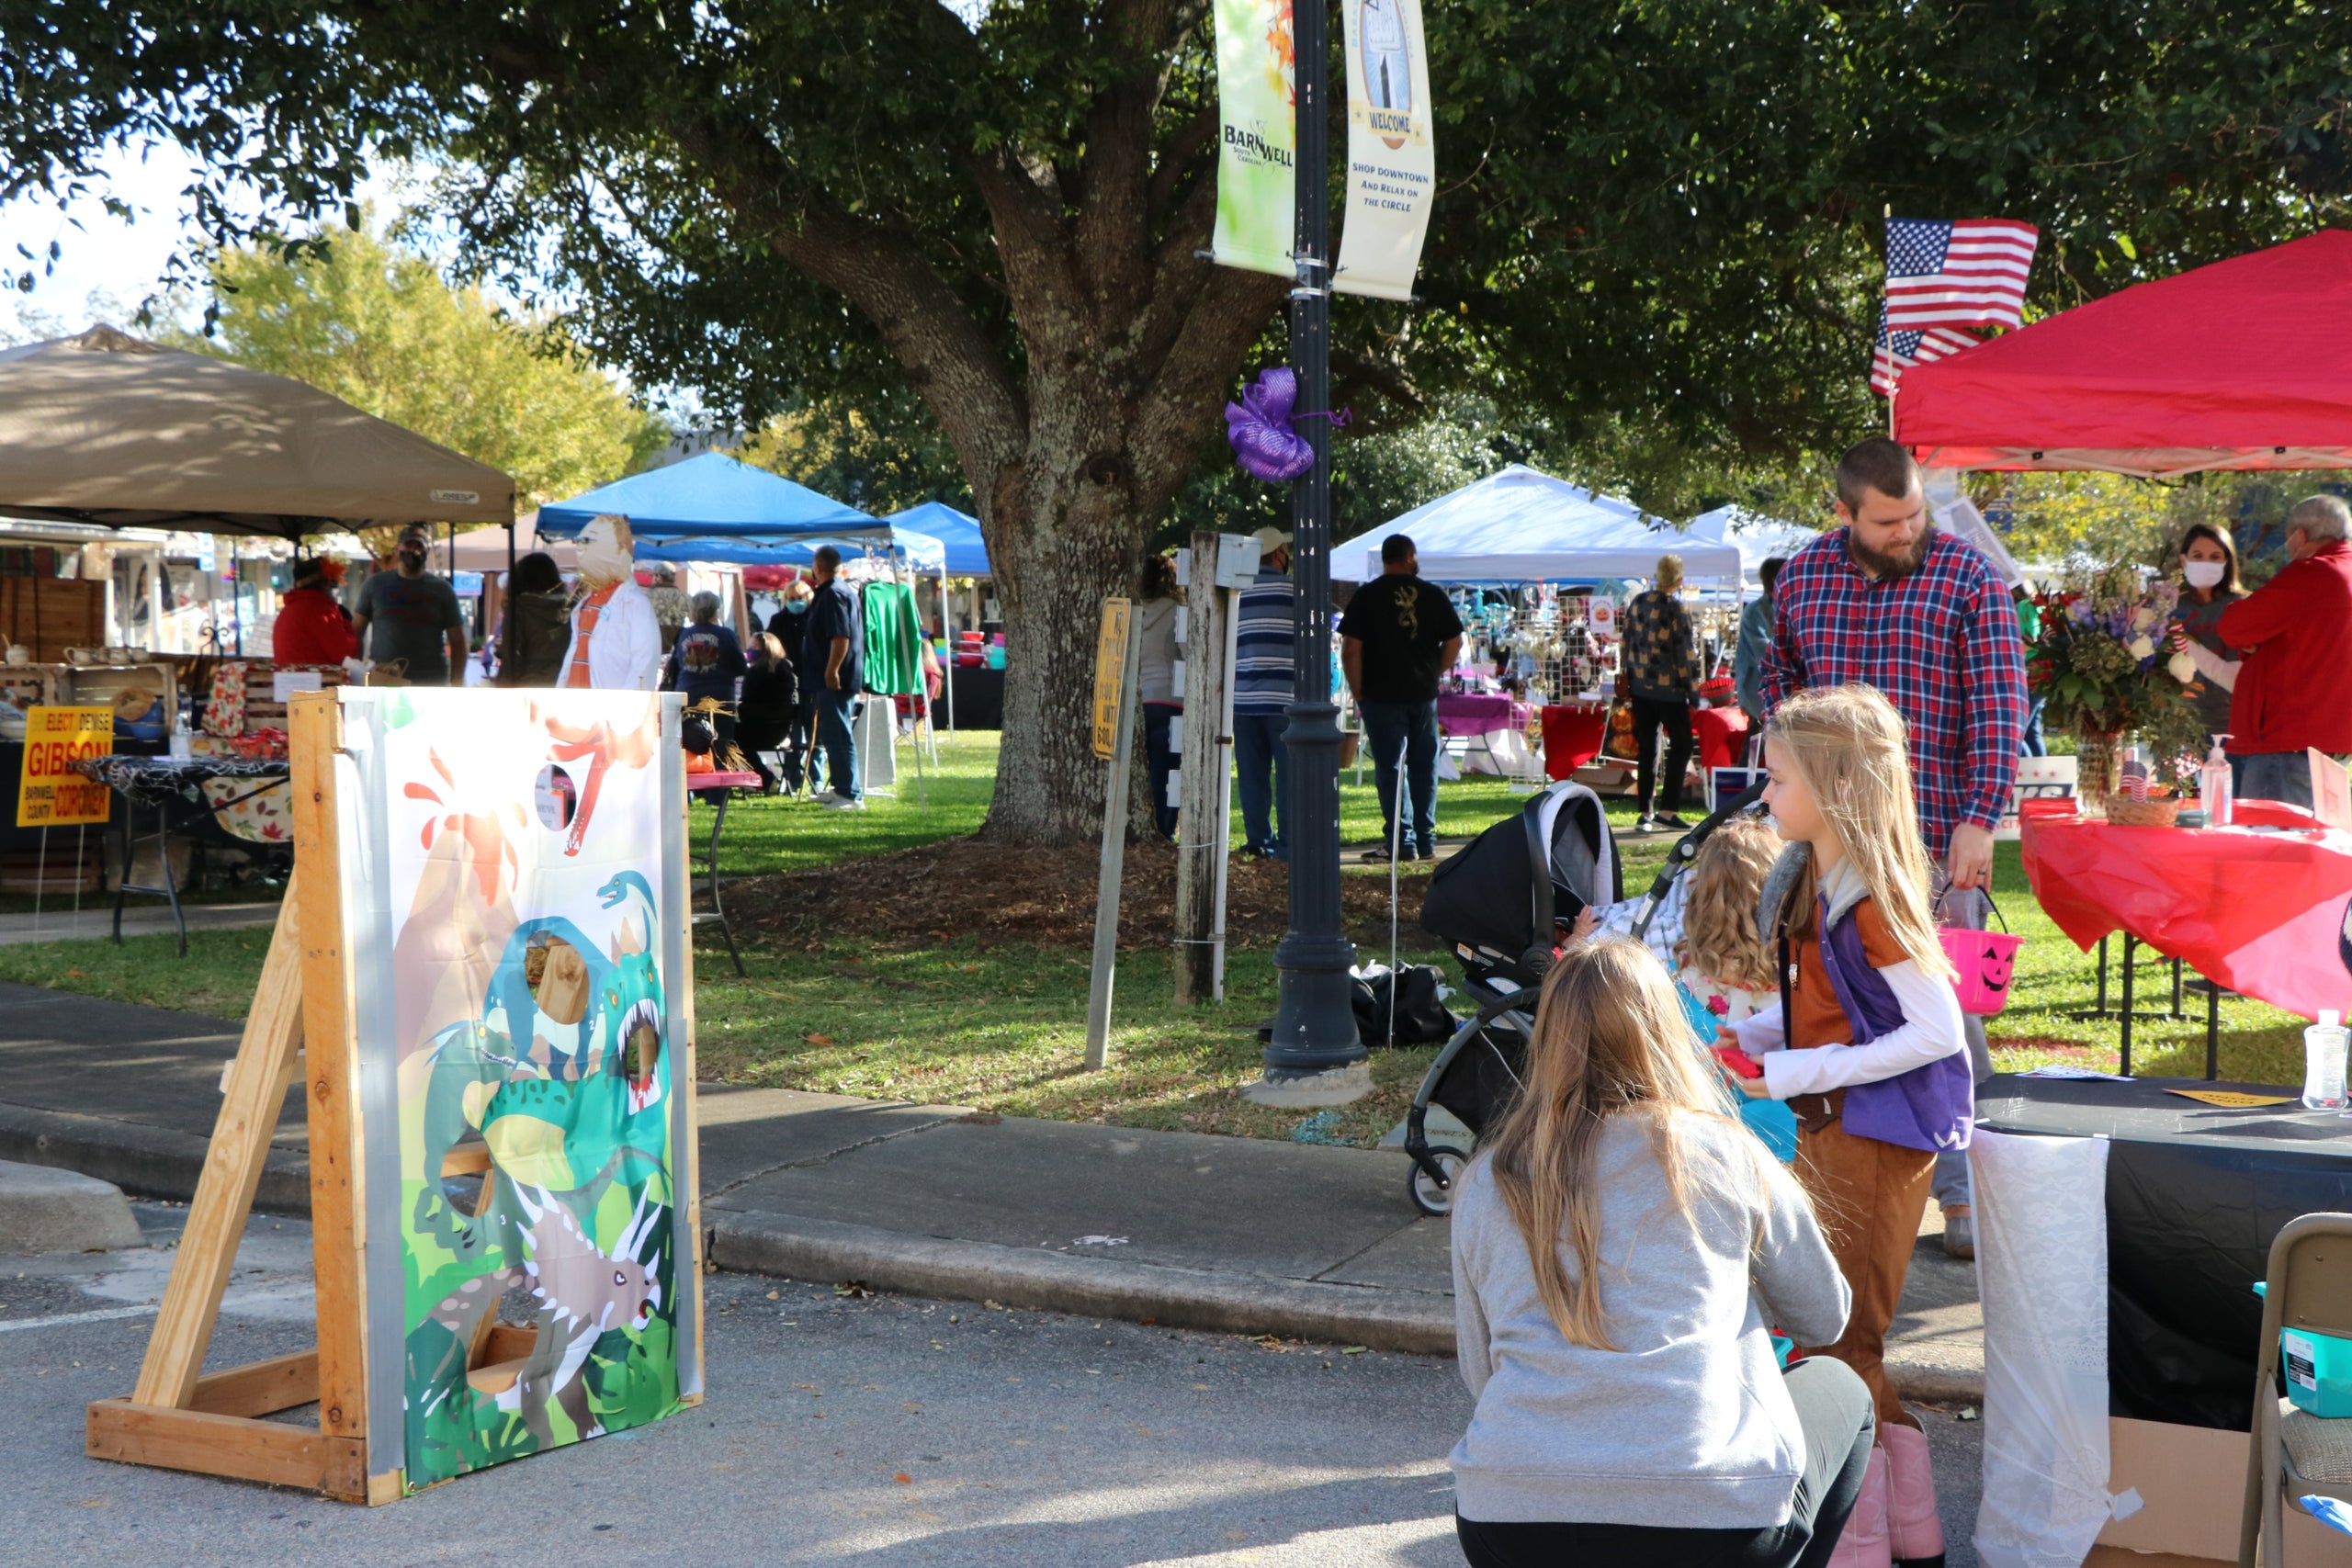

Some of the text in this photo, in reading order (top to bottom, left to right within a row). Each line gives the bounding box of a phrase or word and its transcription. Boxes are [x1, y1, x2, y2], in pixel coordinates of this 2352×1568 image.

[1369, 111, 1410, 133] WELCOME
[1225, 125, 1293, 167] BARNWELL
[1352, 163, 1429, 184] SHOP DOWNTOWN
[1408, 189, 1419, 197] ON
[1364, 197, 1411, 212] THE CIRCLE
[47, 713, 109, 731] ELECT DENISE
[589, 1020, 595, 1031] 2
[638, 1088, 644, 1100] 5
[499, 1213, 506, 1225] 3
